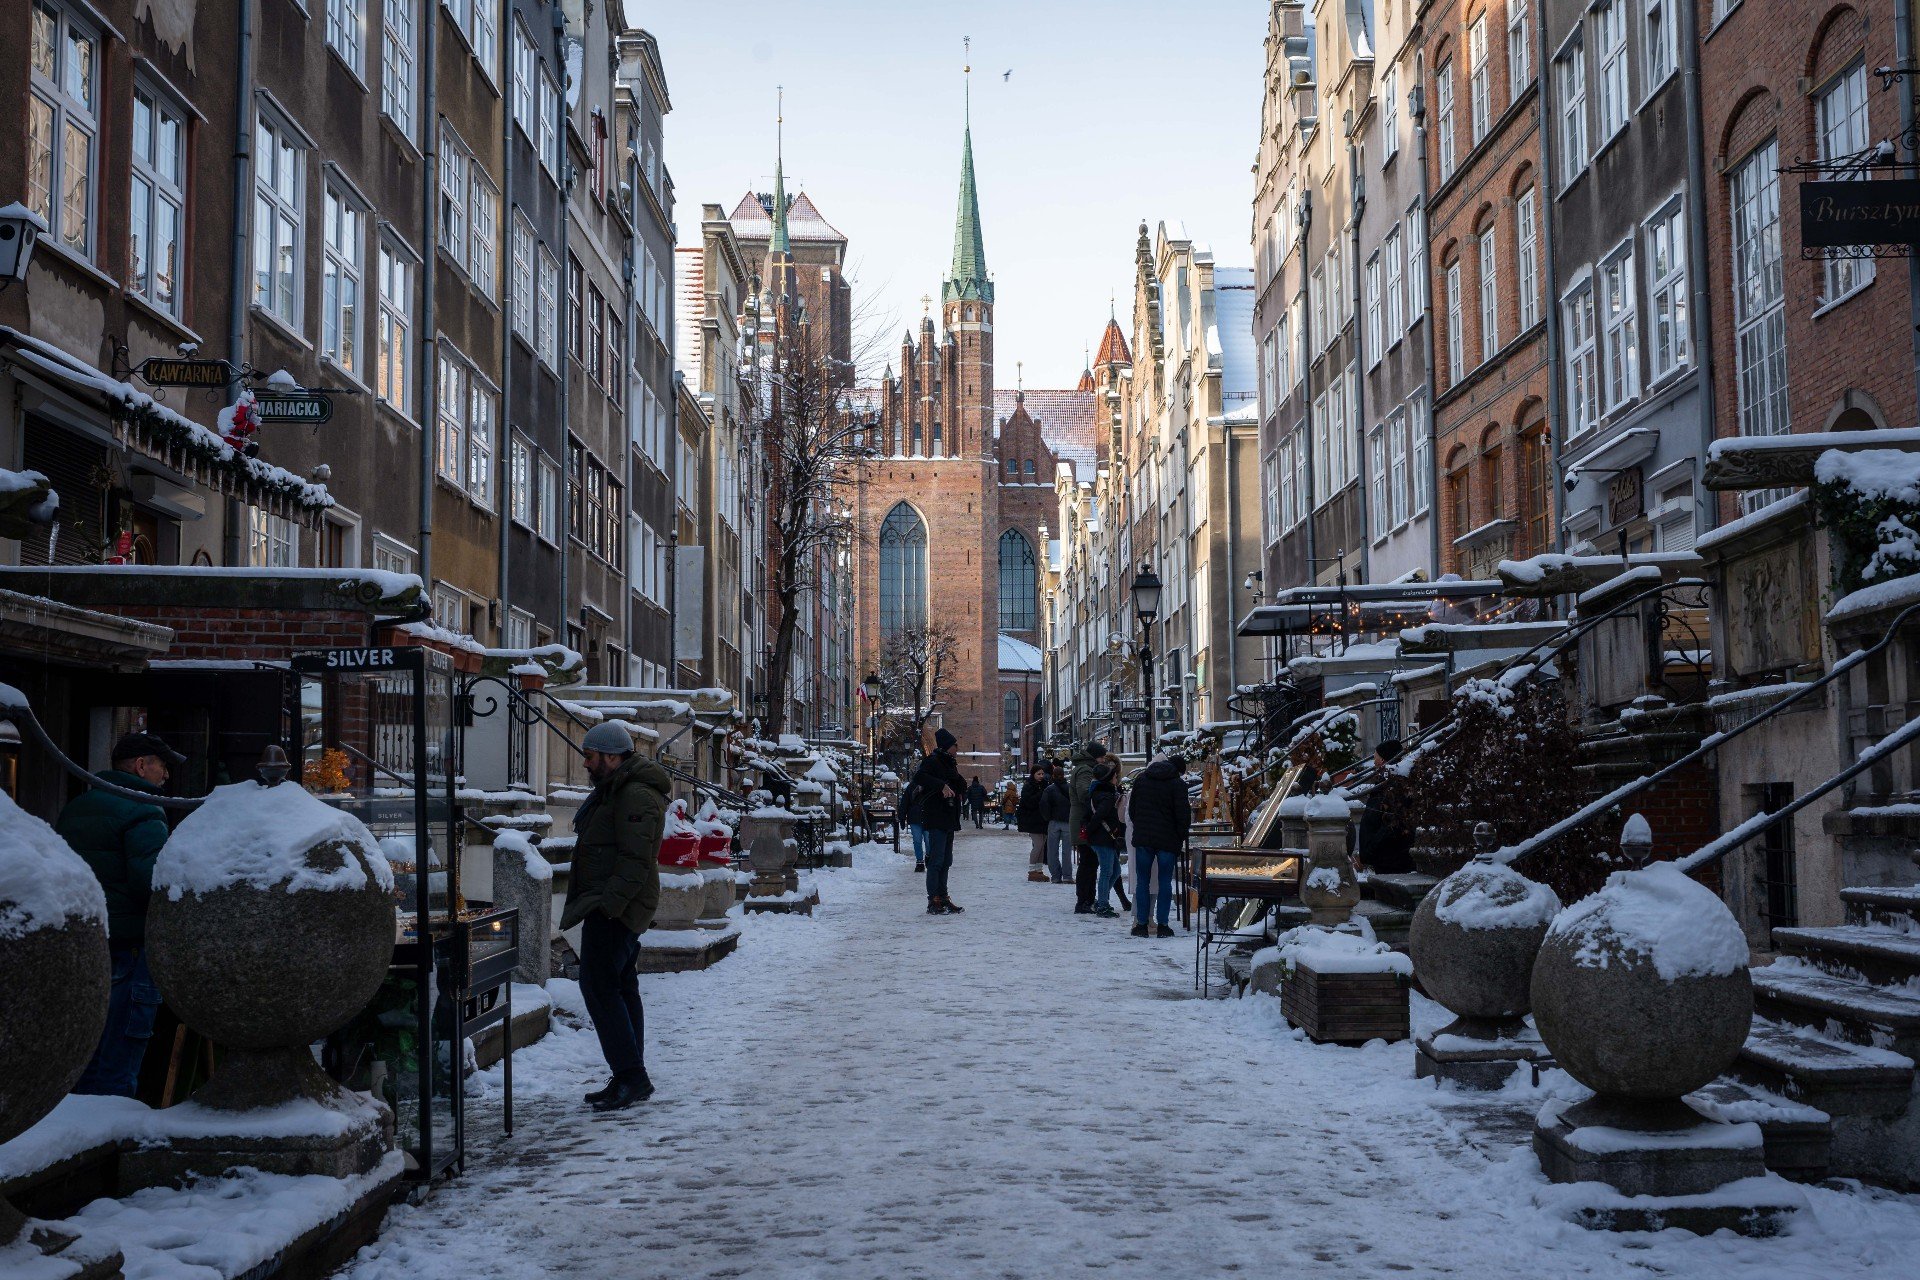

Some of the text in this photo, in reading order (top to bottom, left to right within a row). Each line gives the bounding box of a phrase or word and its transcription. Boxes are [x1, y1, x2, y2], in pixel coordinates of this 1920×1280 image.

[1808, 196, 1920, 227] Bursztyn
[257, 401, 320, 416] MARIACKA
[326, 649, 394, 667] SILVER
[432, 651, 448, 670] SILVER
